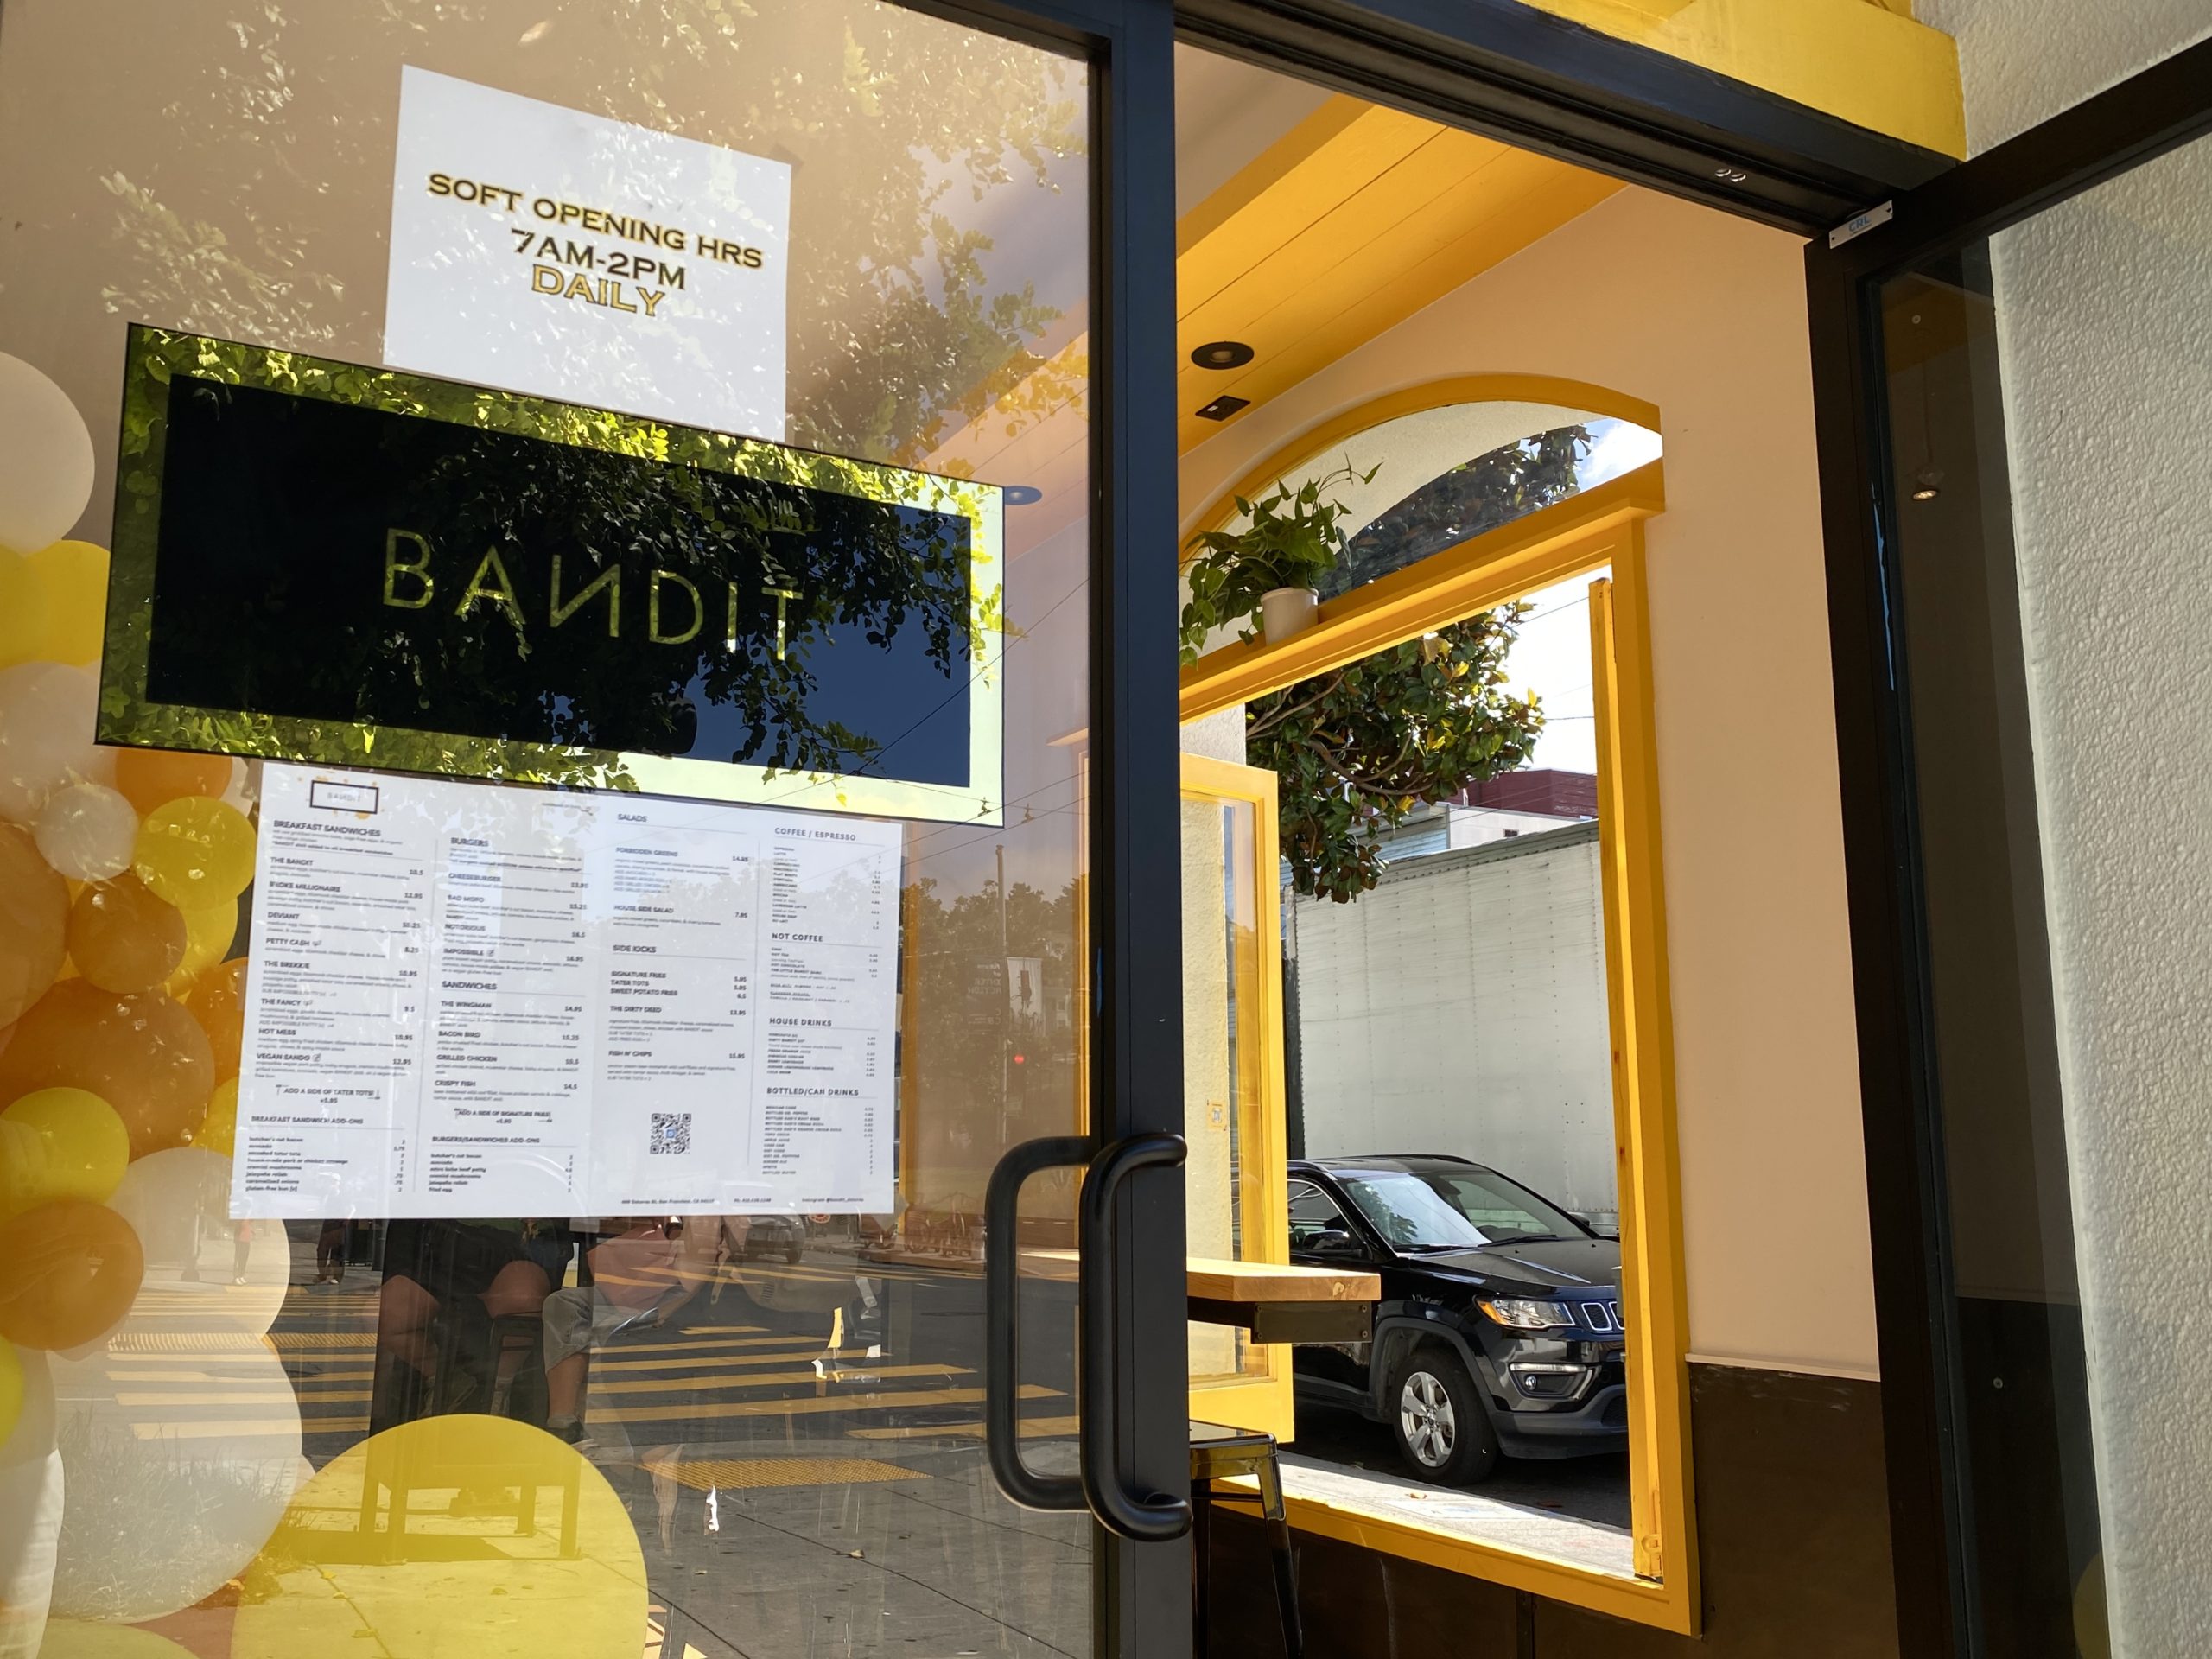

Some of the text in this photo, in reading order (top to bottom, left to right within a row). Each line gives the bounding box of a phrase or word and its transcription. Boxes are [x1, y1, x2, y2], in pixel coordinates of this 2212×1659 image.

[429, 172, 763, 270] SOFT OPENING HRS
[510, 227, 686, 290] 7AM-2PM
[531, 264, 665, 316] DAILY
[274, 820, 381, 836] BREAKFAST SANDWICHES
[774, 828, 806, 836] COFFEE
[815, 832, 856, 841] ESPRESSO
[451, 837, 489, 847] BURGERS
[296, 883, 341, 892] MILLIONAIRE
[442, 981, 497, 990] SANDWICHES
[766, 1087, 825, 1096] BOTTLED/CAN
